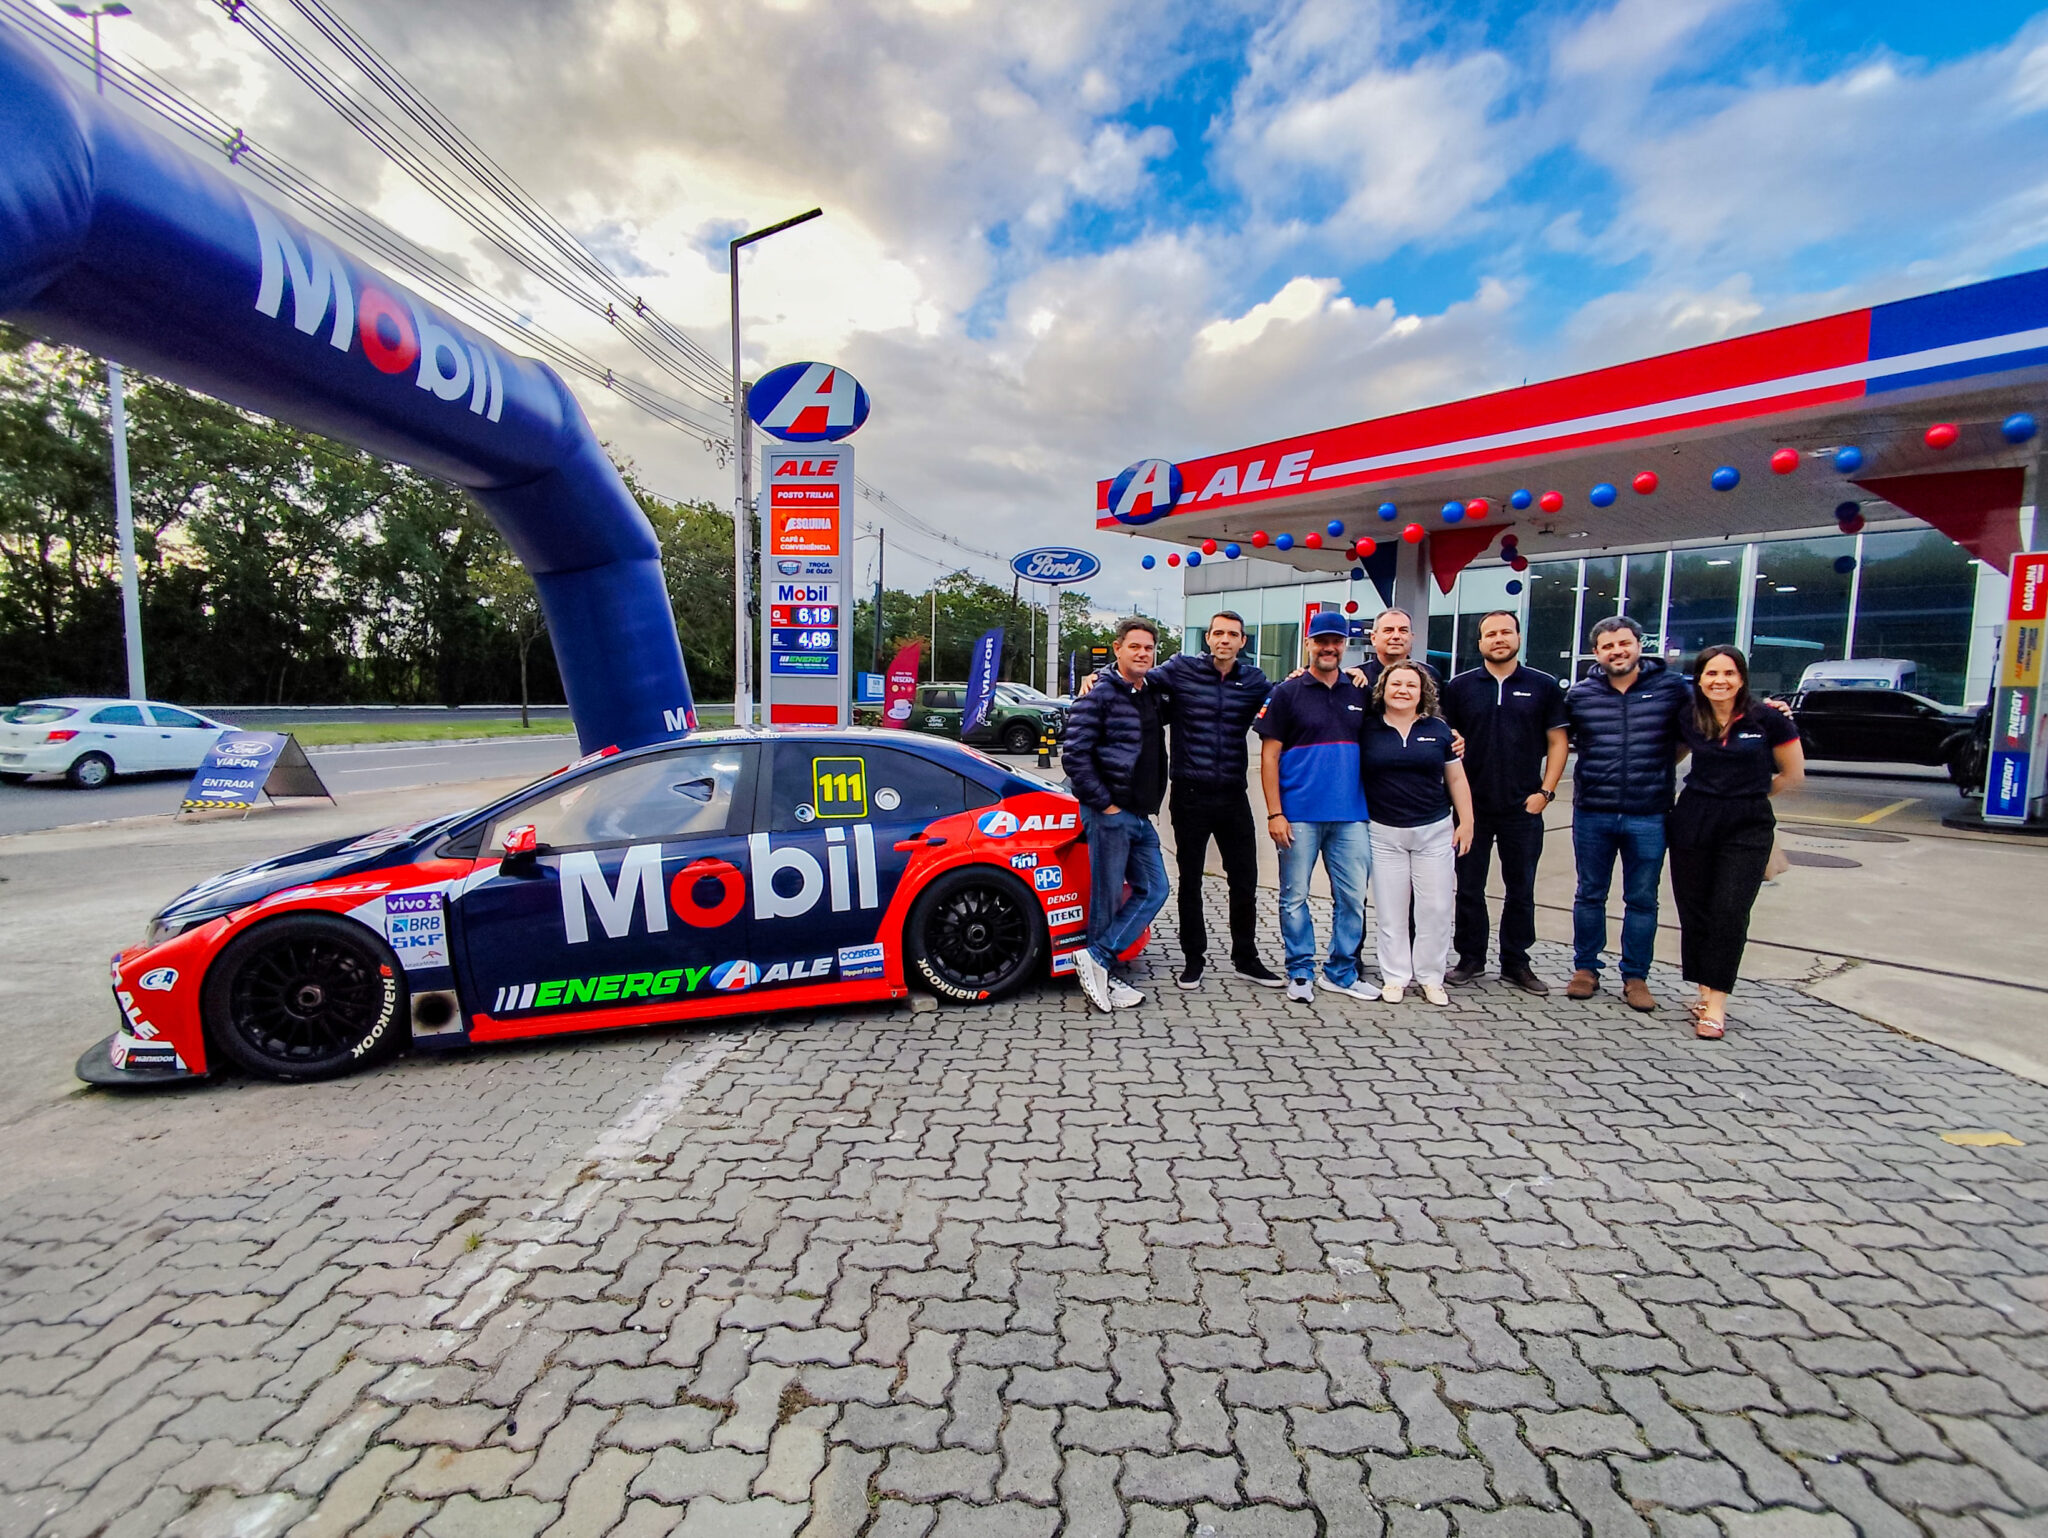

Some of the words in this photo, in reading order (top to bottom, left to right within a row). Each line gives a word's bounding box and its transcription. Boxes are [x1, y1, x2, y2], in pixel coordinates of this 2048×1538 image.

[242, 194, 503, 423] Mobil
[774, 460, 839, 476] ALE
[1197, 450, 1314, 502] ALE
[777, 491, 804, 499] POSTO
[805, 491, 835, 499] TRILHA
[1026, 550, 1082, 577] Ford
[779, 585, 828, 601] Mobil
[772, 610, 781, 619] G
[798, 607, 831, 625] 6,19
[773, 633, 780, 642] E
[798, 631, 831, 649] 4,69
[982, 637, 994, 694] VIAFOR
[2007, 689, 2024, 738] ENERGY
[216, 757, 260, 768] VIAFOR
[202, 778, 255, 788] ENTRADA
[818, 773, 861, 802] 111
[2001, 757, 2015, 801] ENERGY
[1020, 813, 1077, 832] ALE
[560, 824, 878, 943] Mobil
[387, 897, 426, 911] vivo
[1047, 893, 1078, 905] DENSO
[410, 917, 440, 931] BRB
[1050, 908, 1082, 924] JTEKT
[392, 933, 444, 949] SKF
[534, 966, 711, 1007] ENERGY
[760, 957, 833, 984] ALE
[117, 991, 161, 1040] ALE
